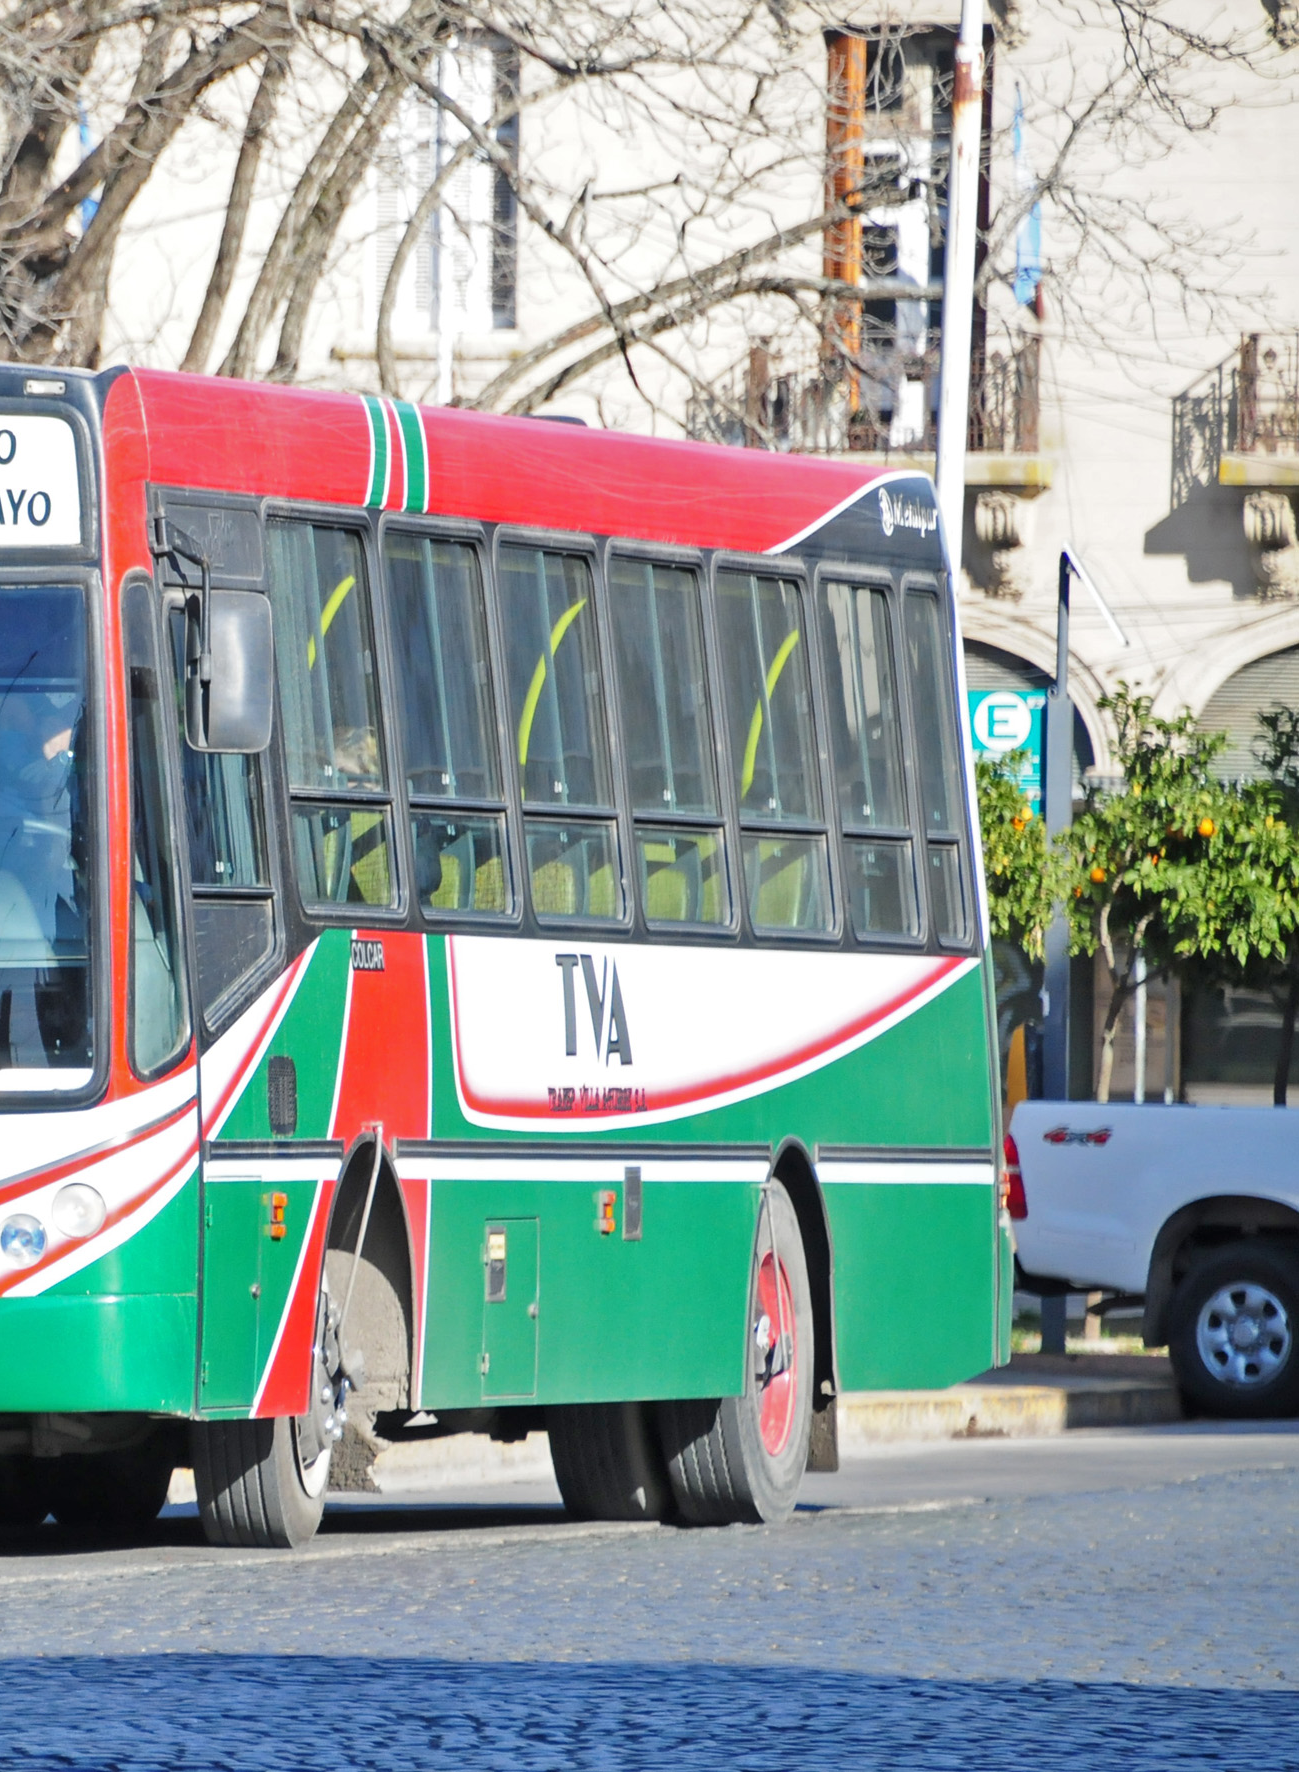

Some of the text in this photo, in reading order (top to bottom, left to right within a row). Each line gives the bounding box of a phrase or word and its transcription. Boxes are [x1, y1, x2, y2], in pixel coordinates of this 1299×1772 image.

[987, 704, 1018, 739] E
[351, 941, 385, 970] COLCAR
[555, 953, 633, 1067] TVA
